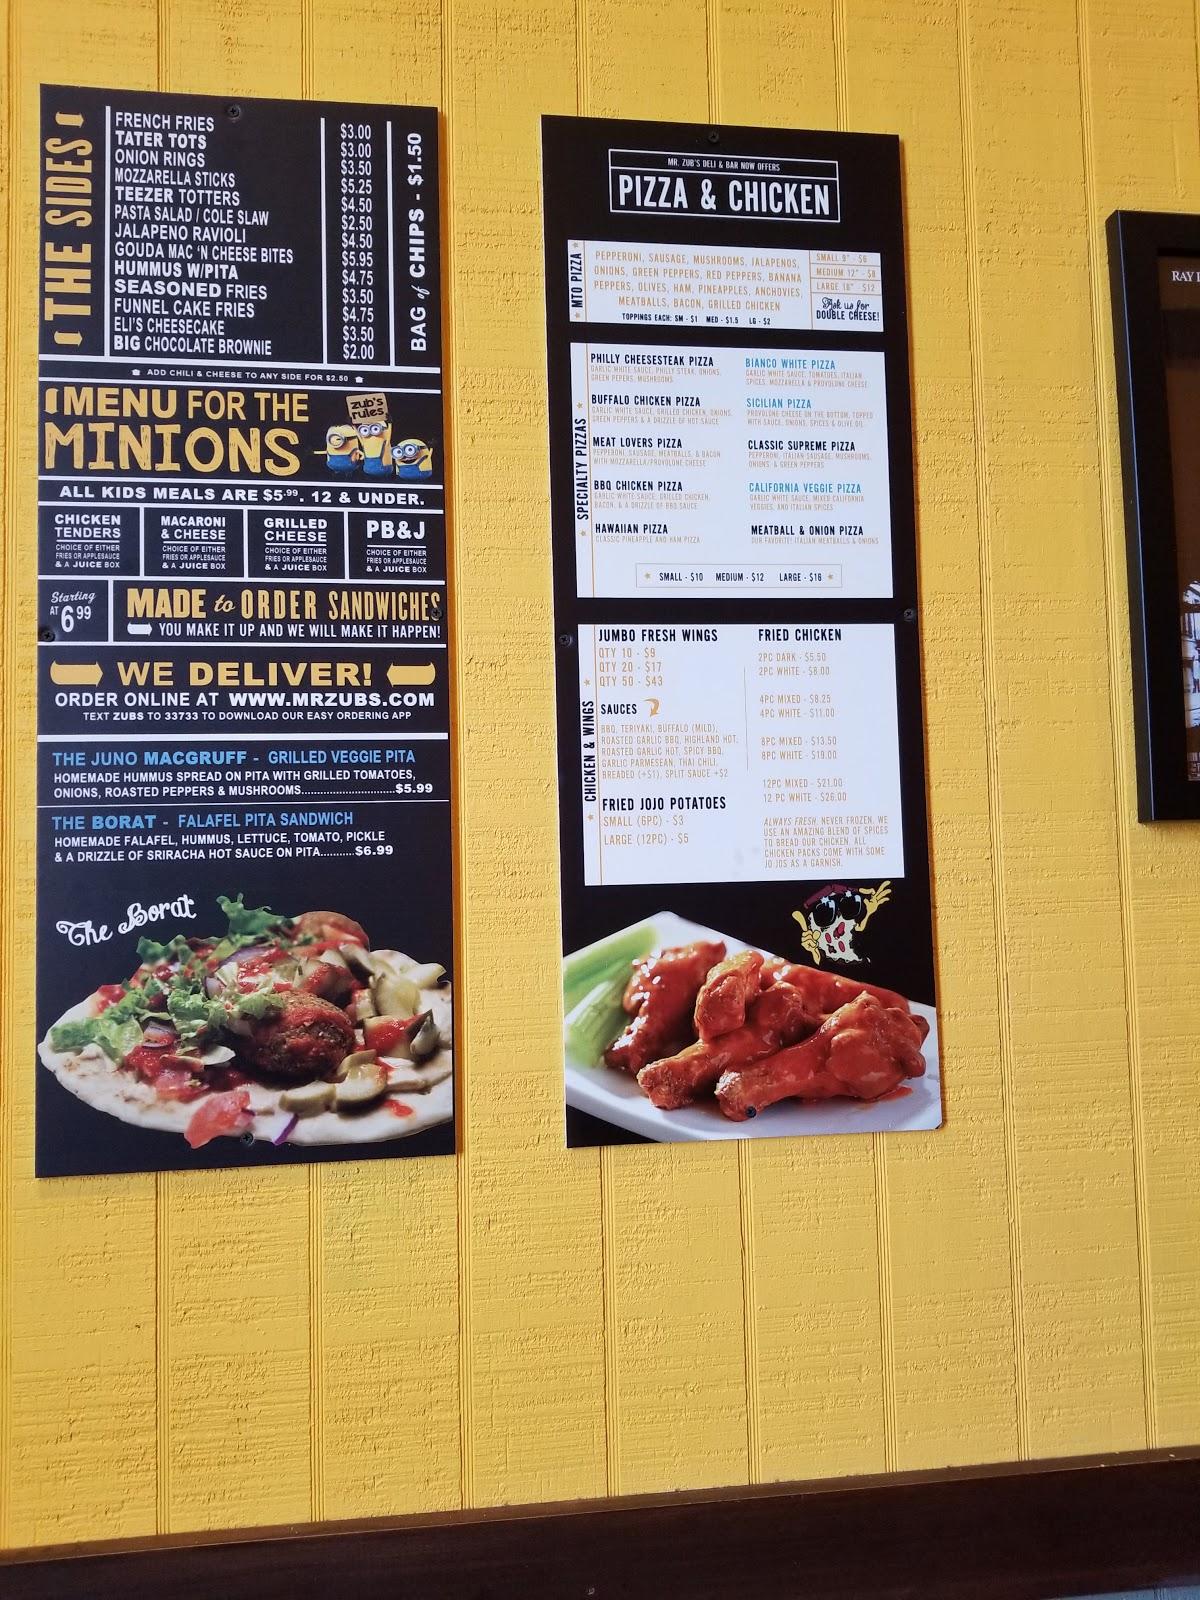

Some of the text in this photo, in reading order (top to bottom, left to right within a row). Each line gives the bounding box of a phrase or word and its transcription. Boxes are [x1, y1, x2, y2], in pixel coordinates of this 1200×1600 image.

[116, 112, 214, 132] FRENCH FRIES
[115, 130, 206, 149] TATER TOTS
[341, 125, 372, 139] $3.00
[341, 143, 372, 157] $3.00
[115, 148, 205, 168] ONION RINGS
[407, 133, 422, 186] $1.50
[682, 159, 700, 167] ZUB'S
[703, 160, 716, 168] DELI
[726, 161, 738, 169] BAR
[741, 162, 755, 170] NOW
[757, 163, 780, 171] OFFERS
[341, 161, 372, 176] $3.50
[115, 167, 235, 188] MOZZARELLA STICKS
[341, 179, 372, 194] $5.25
[115, 186, 240, 206] TEEZER TOTTERS
[619, 175, 829, 215] PIZZA & CHICKEN
[45, 137, 92, 321] THE SIDES
[409, 208, 425, 277] CHIPS
[115, 260, 238, 280] HUMMUS W/PITA
[1172, 270, 1194, 282] RAY
[570, 253, 583, 308] MTO PIZZA
[114, 279, 267, 300] SEASONED FRIES
[417, 286, 430, 299] of
[816, 310, 880, 322] DOUBLE CHEESE!
[410, 306, 426, 351] BAG
[114, 335, 272, 355] BIG CHOCOLATE BROWNIE
[591, 353, 713, 366] PHILLY CHEESESTEAK PIZZA
[746, 358, 835, 370] BIANCO WHITE PIZZA
[64, 386, 309, 422] MENU FOR THE
[351, 397, 383, 410] zub's
[592, 394, 700, 406] BUFFALO CHICKEN PIZZA
[747, 398, 811, 409] SICILIAN PIZZA
[352, 407, 384, 420] rules
[44, 422, 300, 476] MINIONS
[593, 437, 682, 448] MEAT LOVERS PIZZA
[748, 440, 855, 451] CLASSIC SUPREME PIZZA
[574, 418, 589, 520] SPECIALTY PIZZAS
[594, 480, 682, 491] BBQ CHICKEN PIZZA
[749, 483, 861, 493] CALIFORNIA VEGGIE PIZZA
[59, 486, 94, 498] ALL
[102, 486, 146, 499] KIDS
[153, 487, 215, 500] MEALS
[222, 489, 258, 501] ARE
[312, 491, 331, 503] 12
[339, 492, 351, 503] &
[358, 492, 424, 505] UNDER.
[55, 514, 121, 525] CHICKEN
[161, 516, 225, 527] MACARONI
[264, 518, 327, 529] GRILLED
[54, 527, 121, 538] TENDERS
[161, 529, 226, 540] & CHEESE
[367, 520, 425, 539] PB&J
[595, 523, 668, 534] HAWAIIAN PIZZA
[751, 525, 863, 535] MEATBALL & ONION PIZZA
[264, 531, 327, 542] CHEESE
[127, 588, 440, 621] MADE to ORDER SANDWICHES
[599, 629, 718, 642] JUMBO FRESH WINGS
[759, 629, 841, 641] FRIED CHICKEN
[117, 662, 371, 686] WE DELIVER!
[55, 692, 434, 707] ORDER ONLINE AT WWW.MRZUBS.COM
[83, 711, 411, 720] TEXT ZUBS TO 33733 TO DOWNLOAD OUR EASY ORDERING APP
[601, 704, 637, 714] SAUCES
[582, 700, 594, 736] WINGS
[52, 752, 86, 766] THE
[91, 752, 137, 766] JUNO
[144, 751, 247, 765] MACGRUFF
[268, 750, 327, 764] GRILLED
[331, 750, 381, 763] VEGGIE
[386, 750, 415, 763] PITA
[584, 755, 597, 802] CHICKEN
[603, 796, 726, 811] FRIED JOJO POTATOES
[56, 894, 197, 946] The Borat
